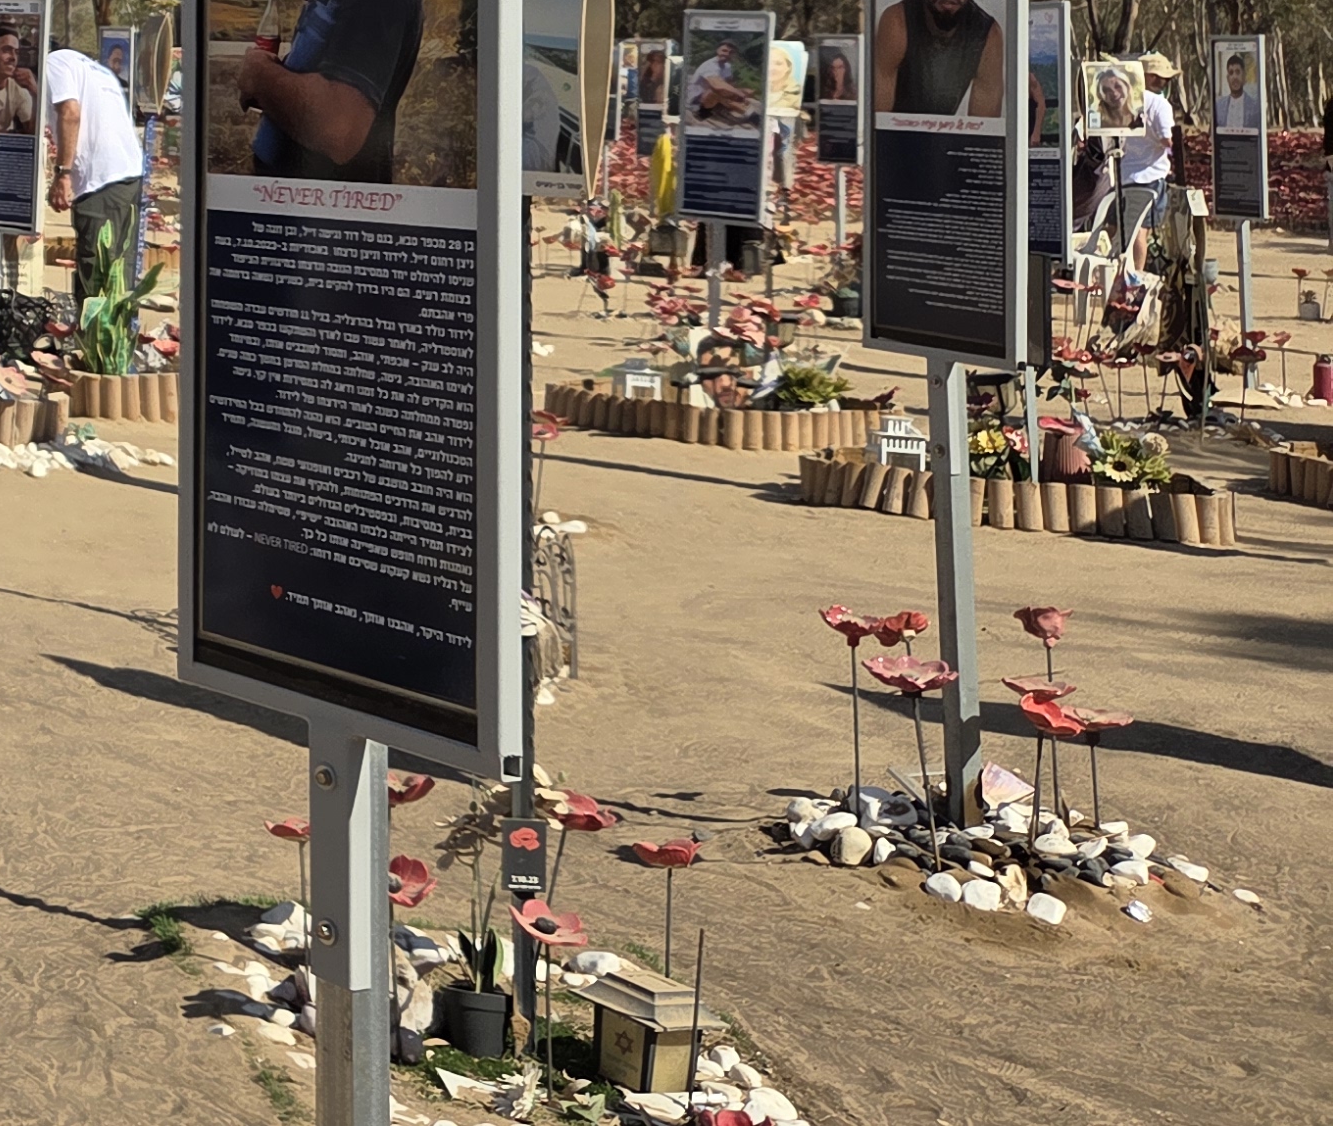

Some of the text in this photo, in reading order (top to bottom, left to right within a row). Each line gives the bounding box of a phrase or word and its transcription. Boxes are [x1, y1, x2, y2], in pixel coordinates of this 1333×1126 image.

[253, 180, 403, 211] “NEVER TIRED”
[343, 230, 358, 240] דוד
[361, 230, 374, 242] של
[420, 237, 445, 248] מכפר
[448, 239, 461, 249] 28
[463, 240, 474, 252] בן
[382, 251, 407, 262] לידור
[456, 258, 473, 269] ניצן
[391, 269, 407, 279] יחד
[410, 270, 445, 283] להימלט
[448, 275, 474, 286] שניסו
[355, 282, 378, 294] בדרך
[380, 285, 394, 295] היו
[396, 287, 409, 297] הם
[440, 292, 471, 304] בצומת
[457, 311, 473, 322] פרי
[375, 317, 395, 330] וגדל
[397, 322, 422, 334] בארץ
[424, 324, 445, 337] נולד
[447, 328, 473, 340] לידור
[421, 360, 439, 371] ענק
[441, 362, 454, 373] לב
[456, 365, 473, 376] היה
[320, 379, 332, 389] לה
[301, 391, 314, 403] של
[376, 386, 388, 399] כל
[390, 391, 404, 401] את
[406, 392, 419, 403] לה
[422, 396, 453, 409] הקדיש
[456, 401, 473, 412] הוא
[325, 415, 340, 425] הוא
[442, 417, 472, 430] נפטרה
[379, 424, 405, 436] החיים
[408, 428, 422, 440] את
[424, 431, 444, 443] אהב
[446, 435, 472, 448] לידור
[368, 437, 390, 451] אוכל
[392, 443, 411, 455] אהב
[333, 466, 360, 480] רכבים
[409, 462, 421, 475] כל
[424, 467, 453, 480] להפוך
[362, 470, 375, 483] של
[455, 473, 472, 484] ידע
[410, 481, 433, 495] חובב
[435, 487, 452, 499] היה
[455, 491, 472, 502] הוא
[421, 502, 435, 513] את
[438, 505, 472, 521] להרגיש
[300, 527, 313, 539] כך.
[315, 529, 326, 541] כל
[254, 532, 281, 547] NEVER
[283, 538, 307, 553] TIRED
[419, 537, 443, 551] תמיד
[446, 542, 472, 557] לצידו
[417, 554, 437, 567] ורוח
[433, 575, 457, 590] רגליו
[459, 580, 472, 593] על
[448, 598, 471, 611] עייף.
[416, 626, 443, 641] היקר,
[445, 632, 471, 648] לידור
